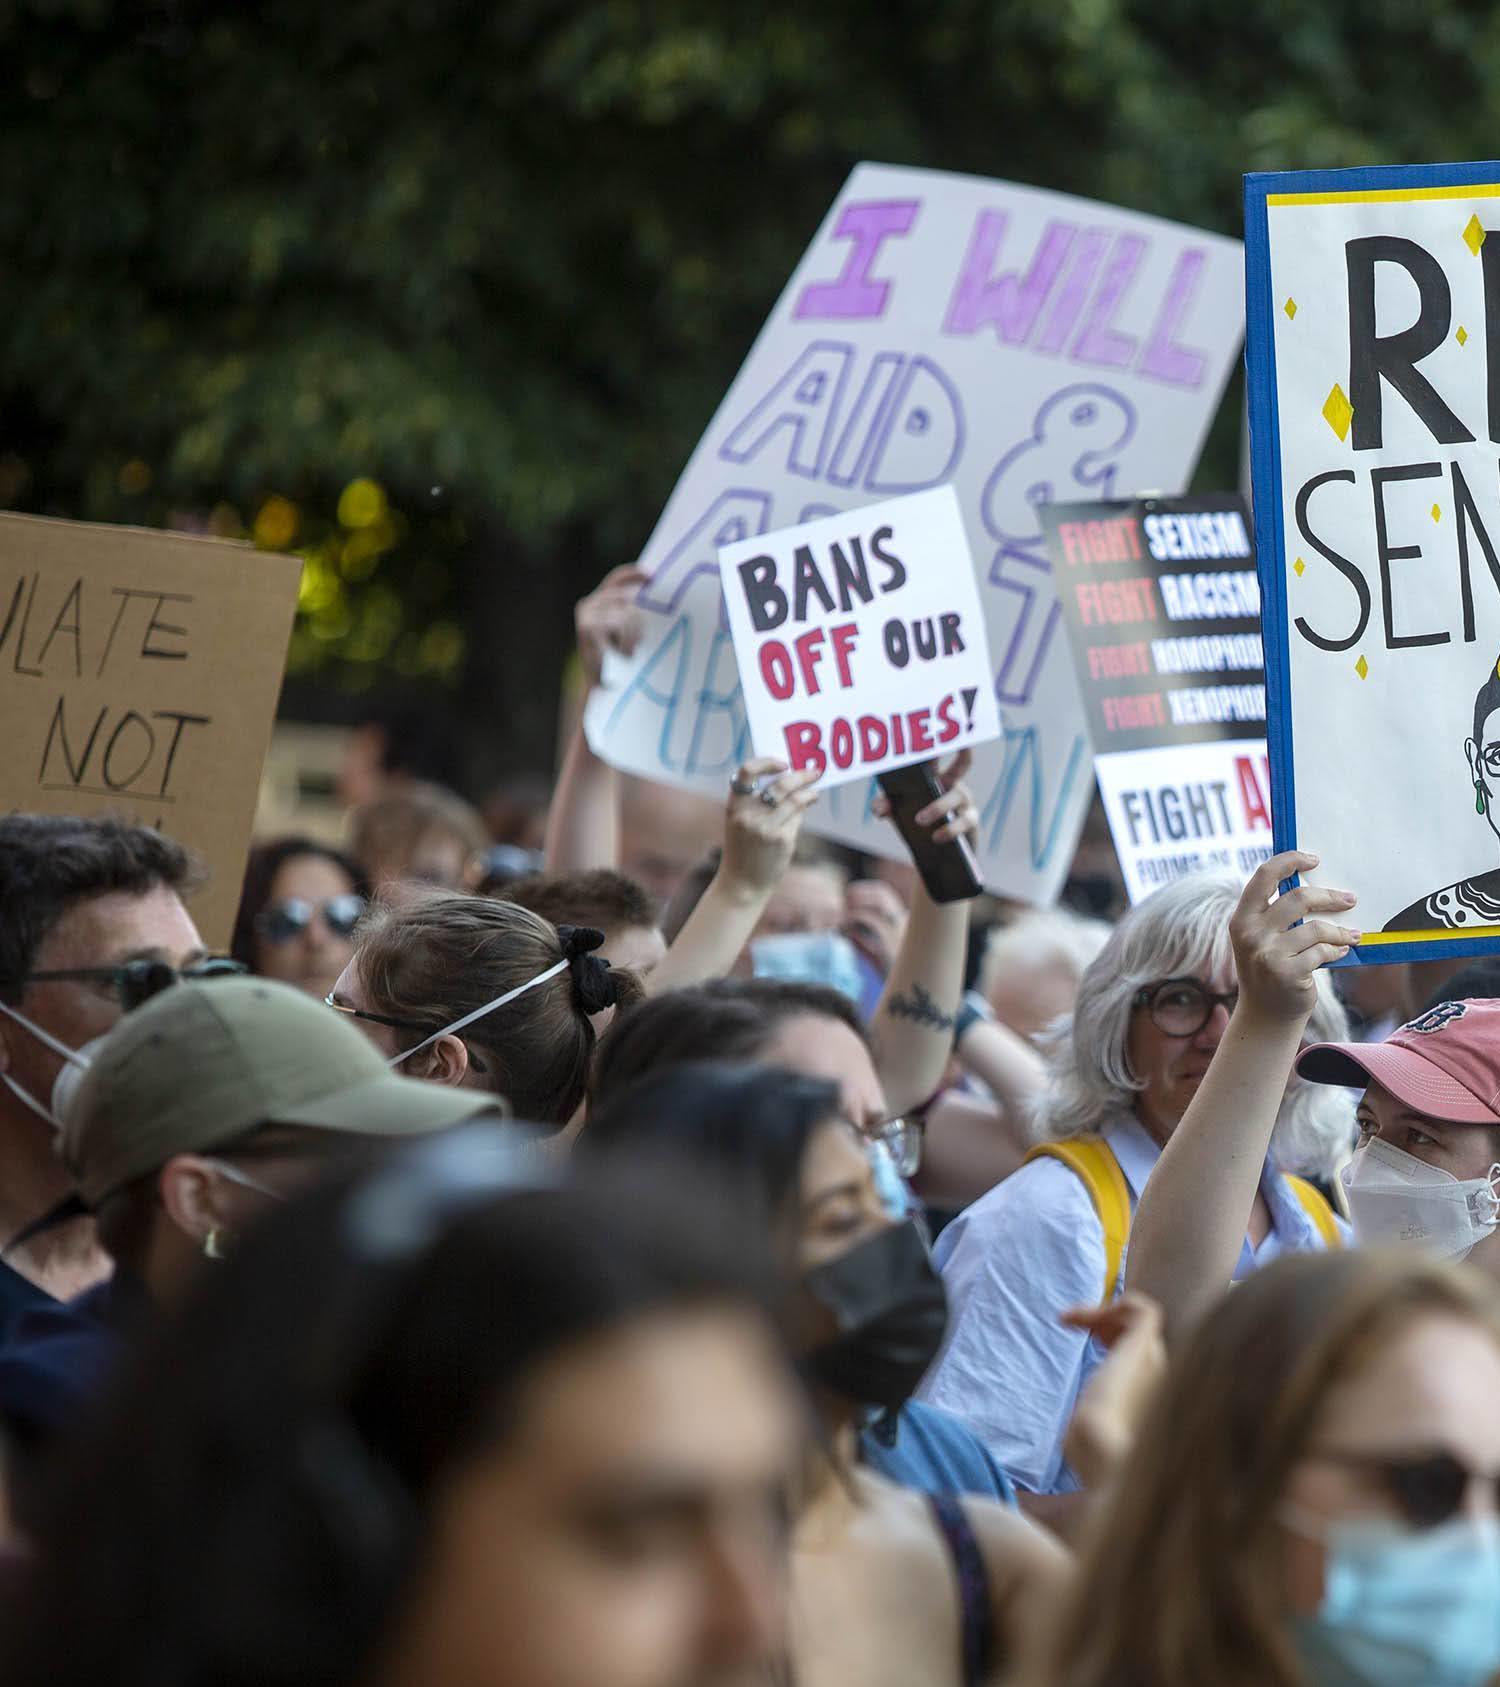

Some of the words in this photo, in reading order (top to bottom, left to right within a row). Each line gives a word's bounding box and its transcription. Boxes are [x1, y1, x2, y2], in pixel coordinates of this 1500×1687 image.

[790, 198, 923, 321] I
[941, 208, 1210, 391] WILL
[717, 339, 966, 493] AID
[737, 525, 906, 633] BANS
[1058, 516, 1142, 566] FIGHT
[1143, 511, 1251, 561] SEXISM
[1075, 577, 1157, 626] FIGHT
[759, 622, 859, 701] OFF
[884, 612, 965, 669] OUR
[38, 697, 211, 798] NOT
[782, 687, 978, 781] BODIES!
[1120, 783, 1232, 846] FIGHT
[1234, 755, 1272, 830] A
